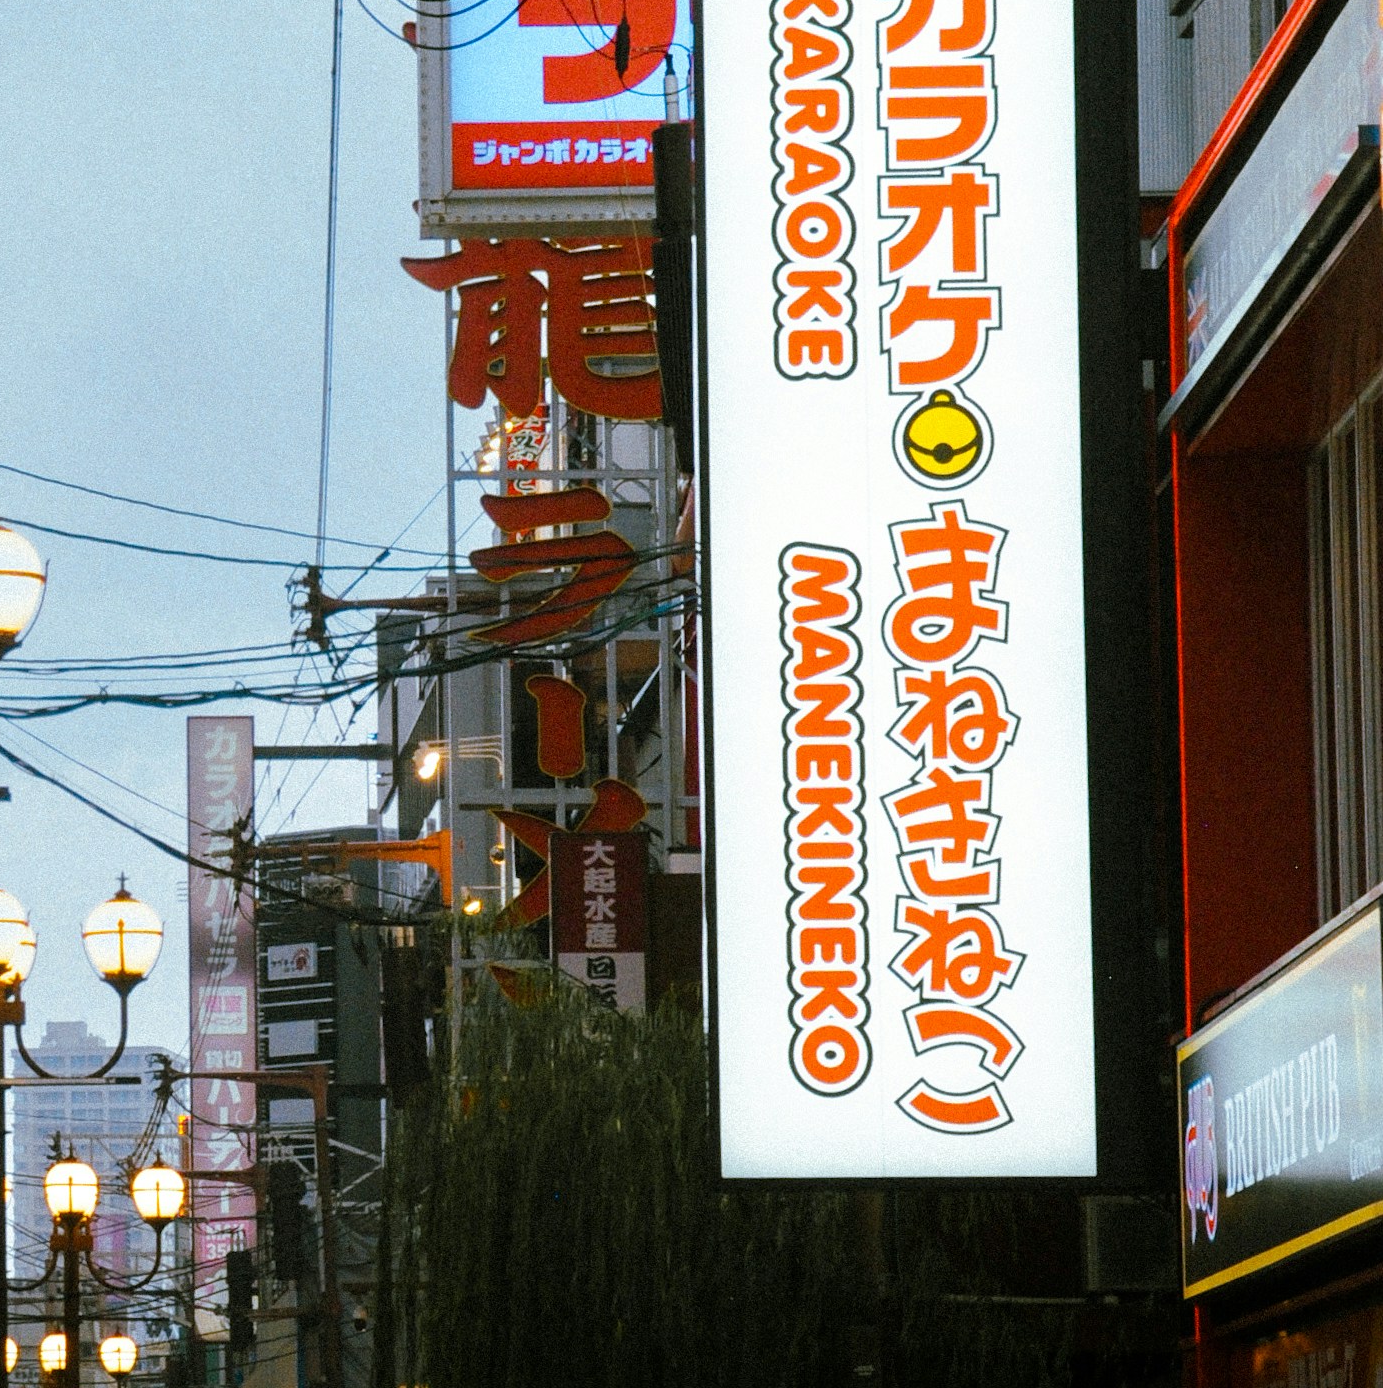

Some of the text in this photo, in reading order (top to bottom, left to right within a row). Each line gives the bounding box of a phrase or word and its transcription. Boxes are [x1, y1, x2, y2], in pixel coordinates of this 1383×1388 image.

[472, 138, 654, 165] ジャンボカラオ
[401, 222, 663, 1004] 龍ラーメ
[582, 839, 618, 950] 大起水産
[788, 550, 864, 1088] MANEKINEKO
[890, 507, 1016, 1126] まねきねこ
[1224, 1058, 1298, 1199] BRITISH
[1298, 1033, 1341, 1158] PUB
